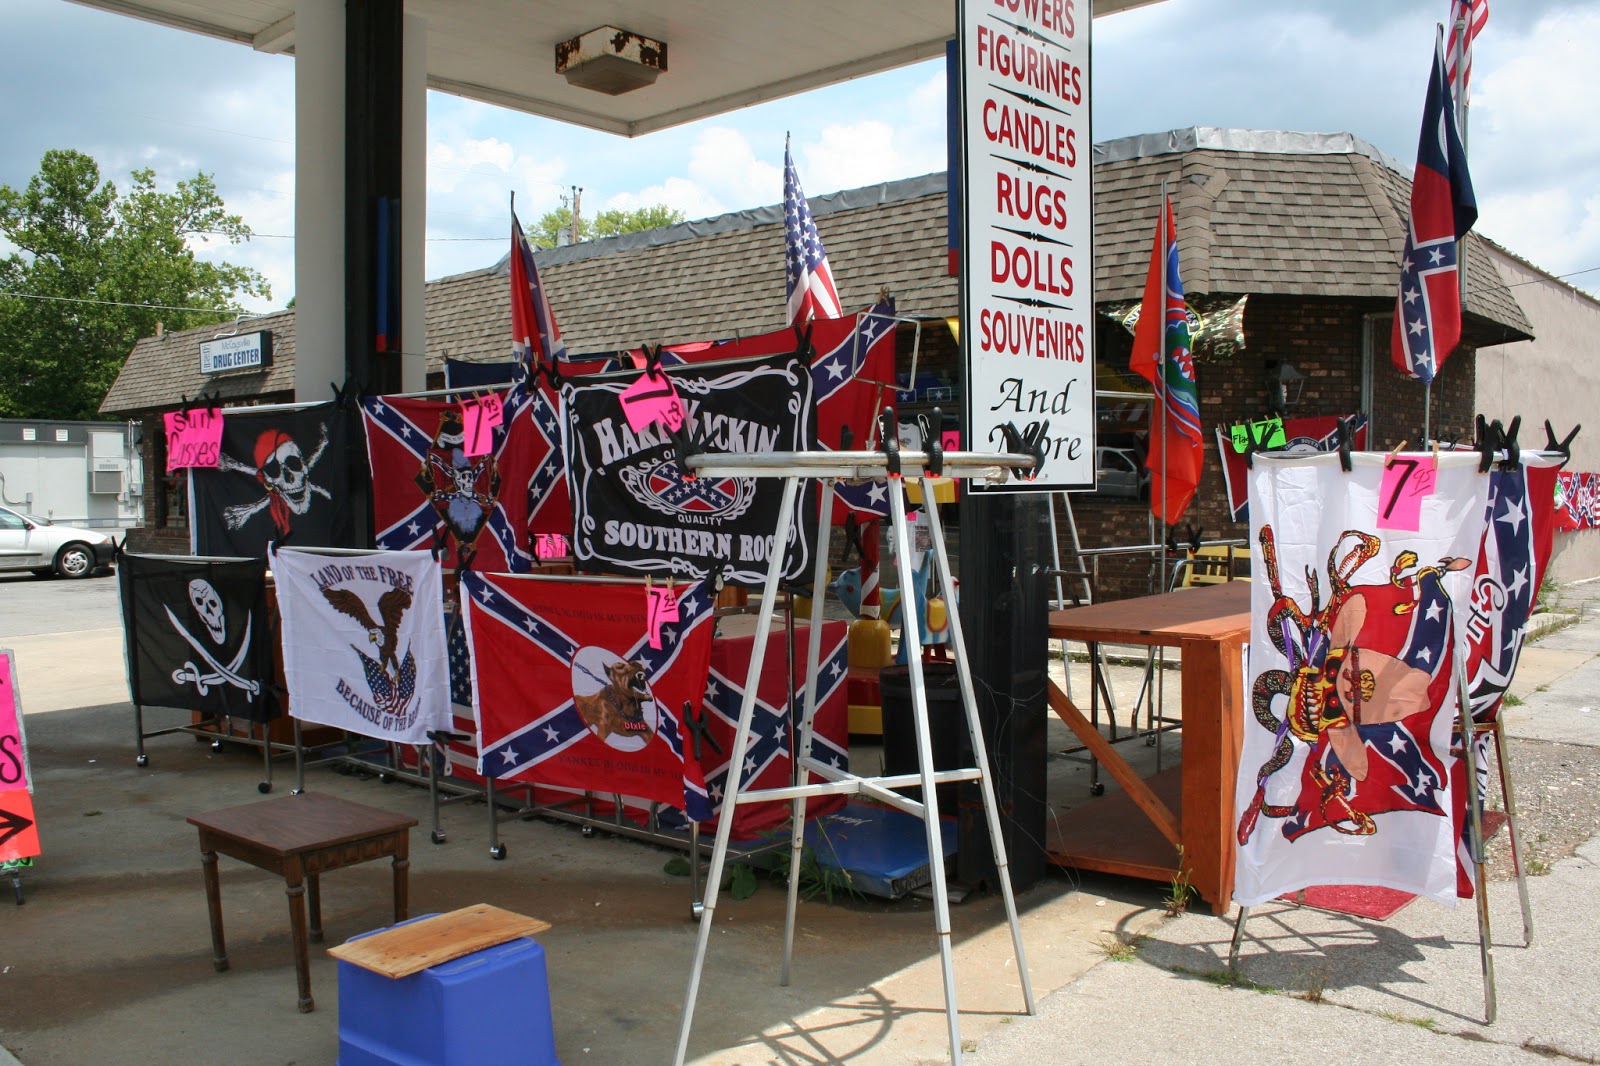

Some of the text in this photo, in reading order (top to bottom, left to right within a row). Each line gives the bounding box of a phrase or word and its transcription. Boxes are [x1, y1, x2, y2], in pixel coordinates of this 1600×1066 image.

[995, 0, 1073, 38] WERS
[978, 26, 1081, 105] FIGURINES
[984, 100, 1076, 168] CANDLES
[998, 172, 1067, 230] RUGS
[992, 241, 1073, 296] DOLLS
[213, 353, 232, 368] DRUG
[234, 348, 260, 365] CENTER
[981, 309, 1084, 362] SOUVENIRS
[990, 378, 1077, 415] And
[169, 432, 218, 468] Gasses
[1383, 459, 1419, 520] 7
[604, 520, 732, 560] SOUTHERN
[739, 534, 776, 563] ROC
[678, 514, 723, 526] QUALITY
[310, 564, 415, 596] LAND OF THE FREE
[336, 677, 381, 726] BECAUSE
[383, 715, 393, 731] OF
[395, 717, 407, 731] THE
